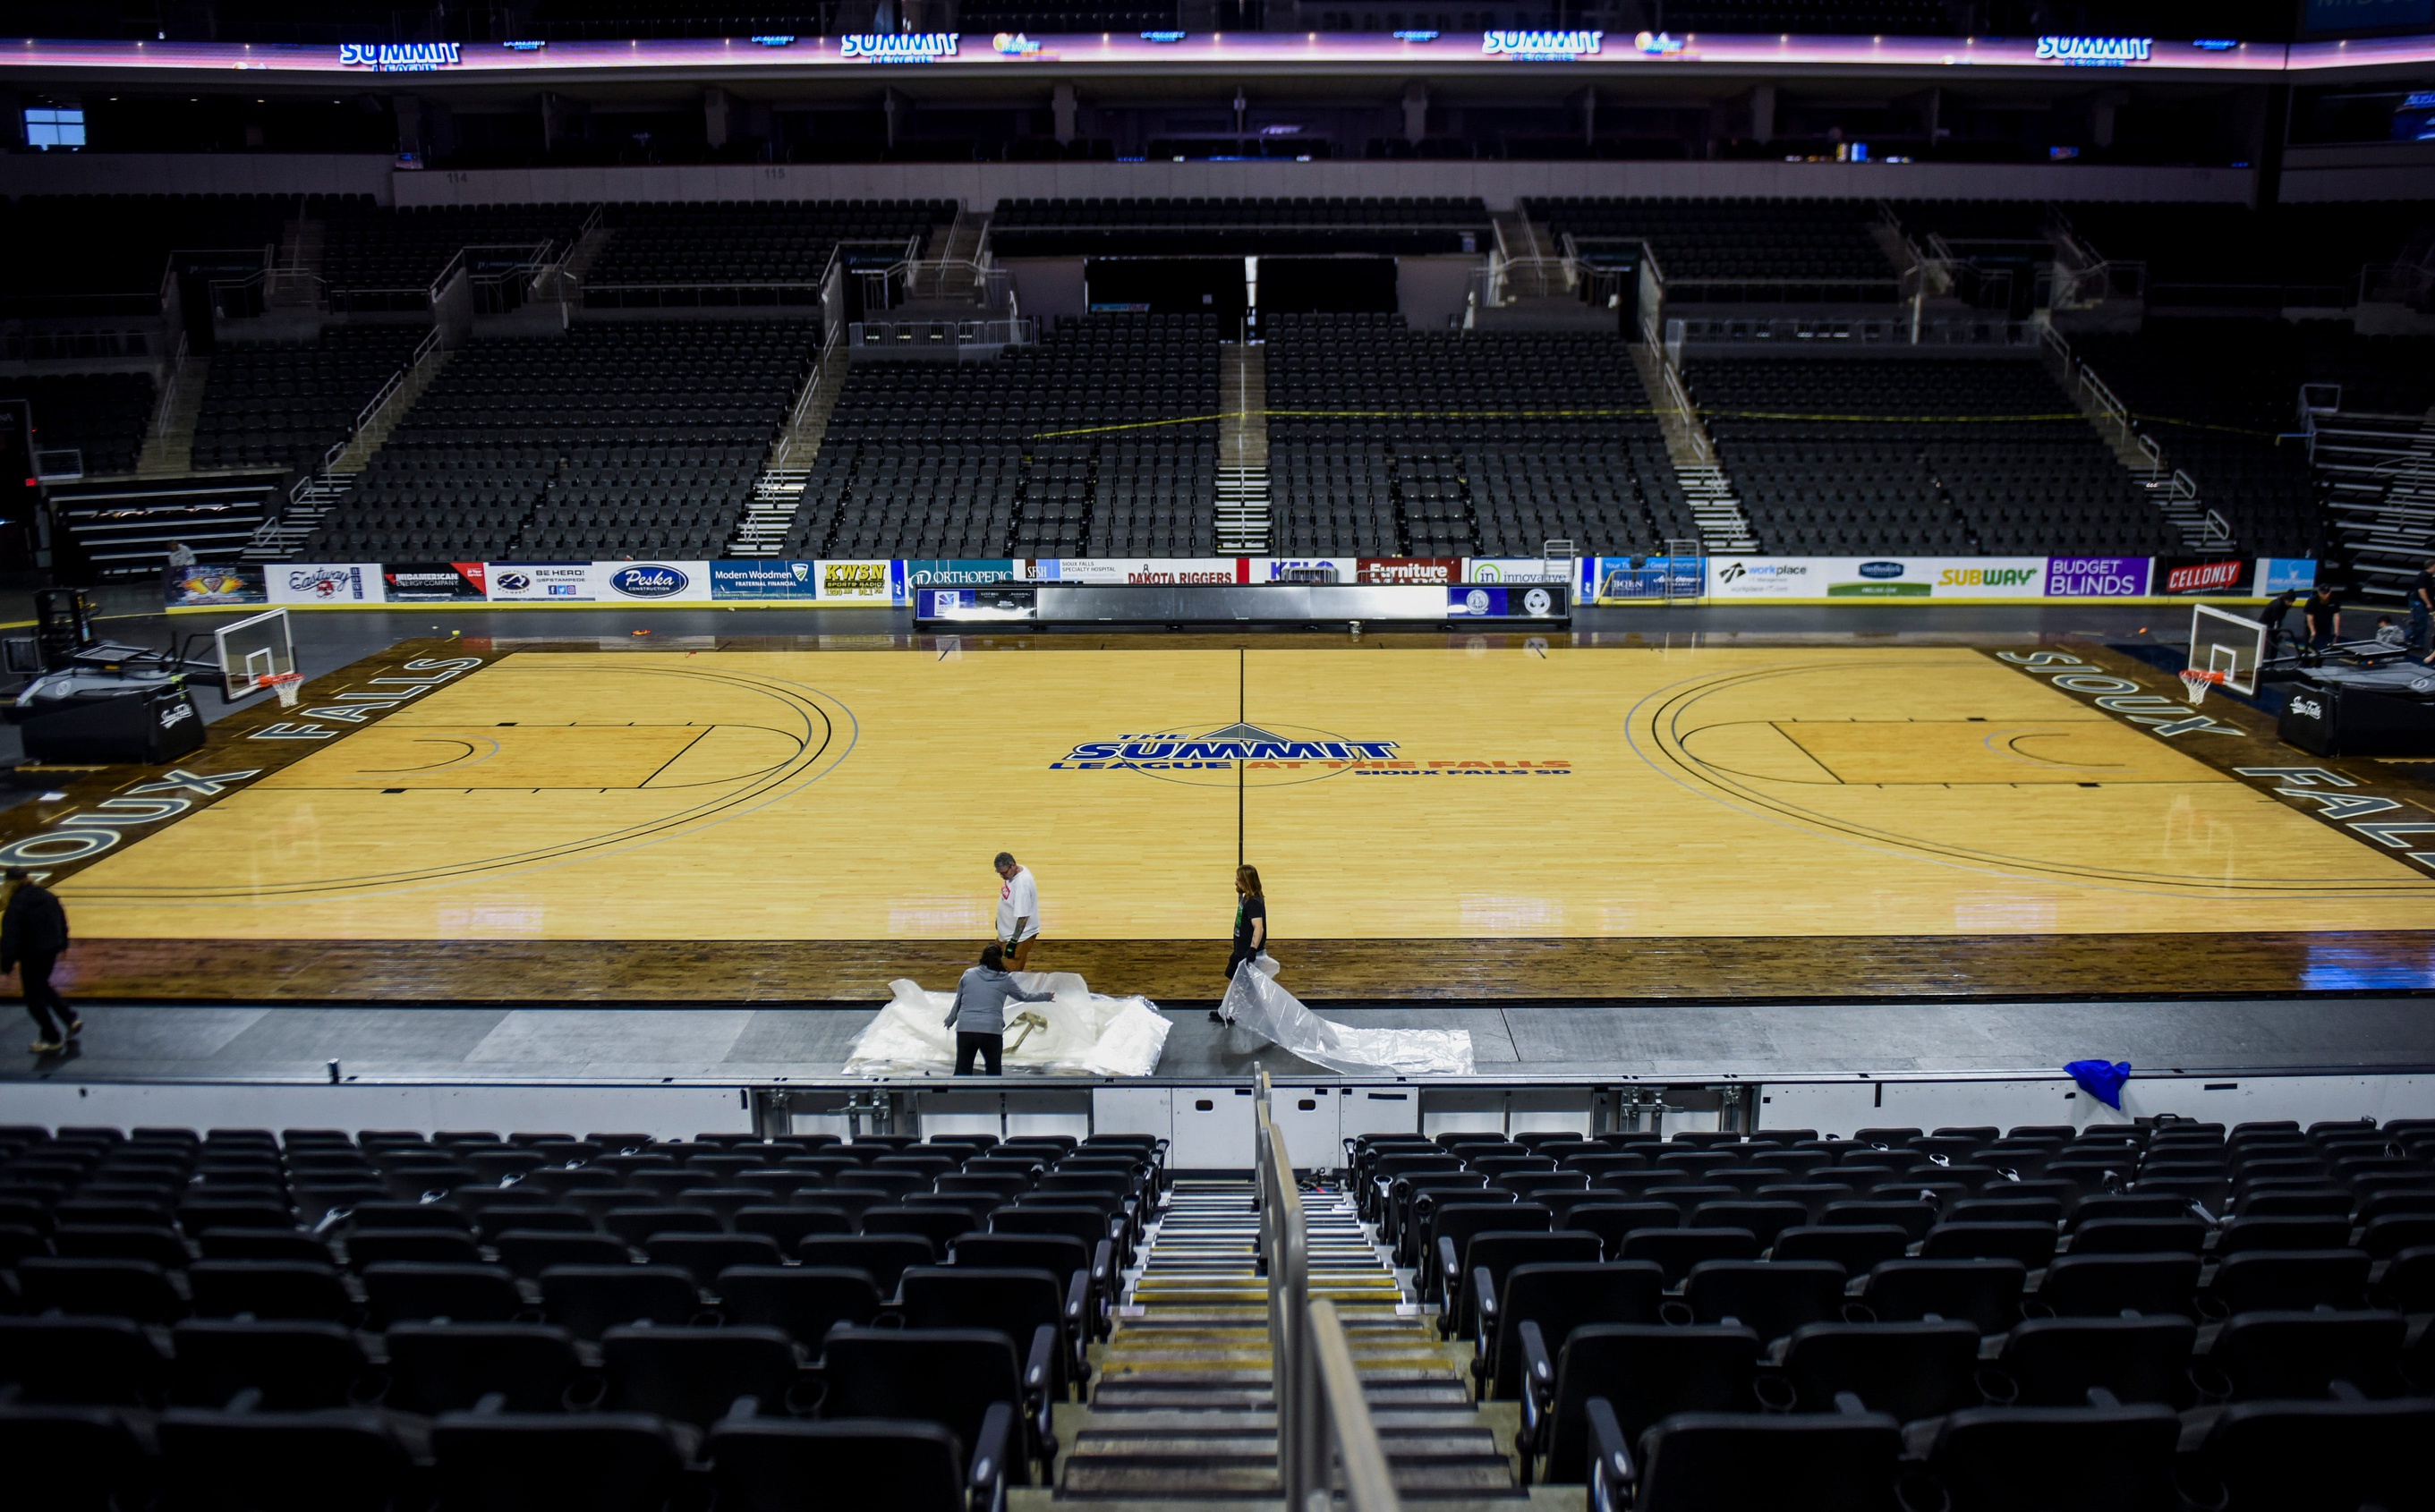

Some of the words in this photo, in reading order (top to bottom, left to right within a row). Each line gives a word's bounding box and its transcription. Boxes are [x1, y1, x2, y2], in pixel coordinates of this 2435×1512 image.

[839, 33, 958, 56] SUMMIT
[1482, 31, 1603, 54] SUMMIT
[2035, 37, 2152, 59] SUMMIT
[340, 43, 459, 64] SUMMIT
[715, 571, 748, 579] Modern
[749, 571, 793, 579] Woodmen
[825, 565, 886, 581] KWSN
[1370, 563, 1448, 578] Furniture
[1749, 565, 1807, 577] workplace
[2052, 559, 2123, 575] BUDGET
[289, 566, 352, 591] Eastway
[626, 570, 675, 587] Peska
[933, 571, 1013, 583] ORTHOPEDIC
[1128, 573, 1175, 584] DAKOTA
[1179, 573, 1232, 584] RIGGERS
[1937, 568, 2038, 587] SUBWAY
[2050, 575, 2135, 595] BLINDS
[2169, 565, 2237, 589] CELLONLY
[1062, 742, 1401, 760] SUMMIT
[1996, 650, 2247, 737] SIOUX
[2232, 767, 2435, 870] FAL
[0, 769, 263, 886] OUX
[247, 657, 484, 740] FALLS
[1245, 761, 1309, 769] AT
[1319, 761, 1417, 769] THE
[1427, 760, 1572, 769] FALLS
